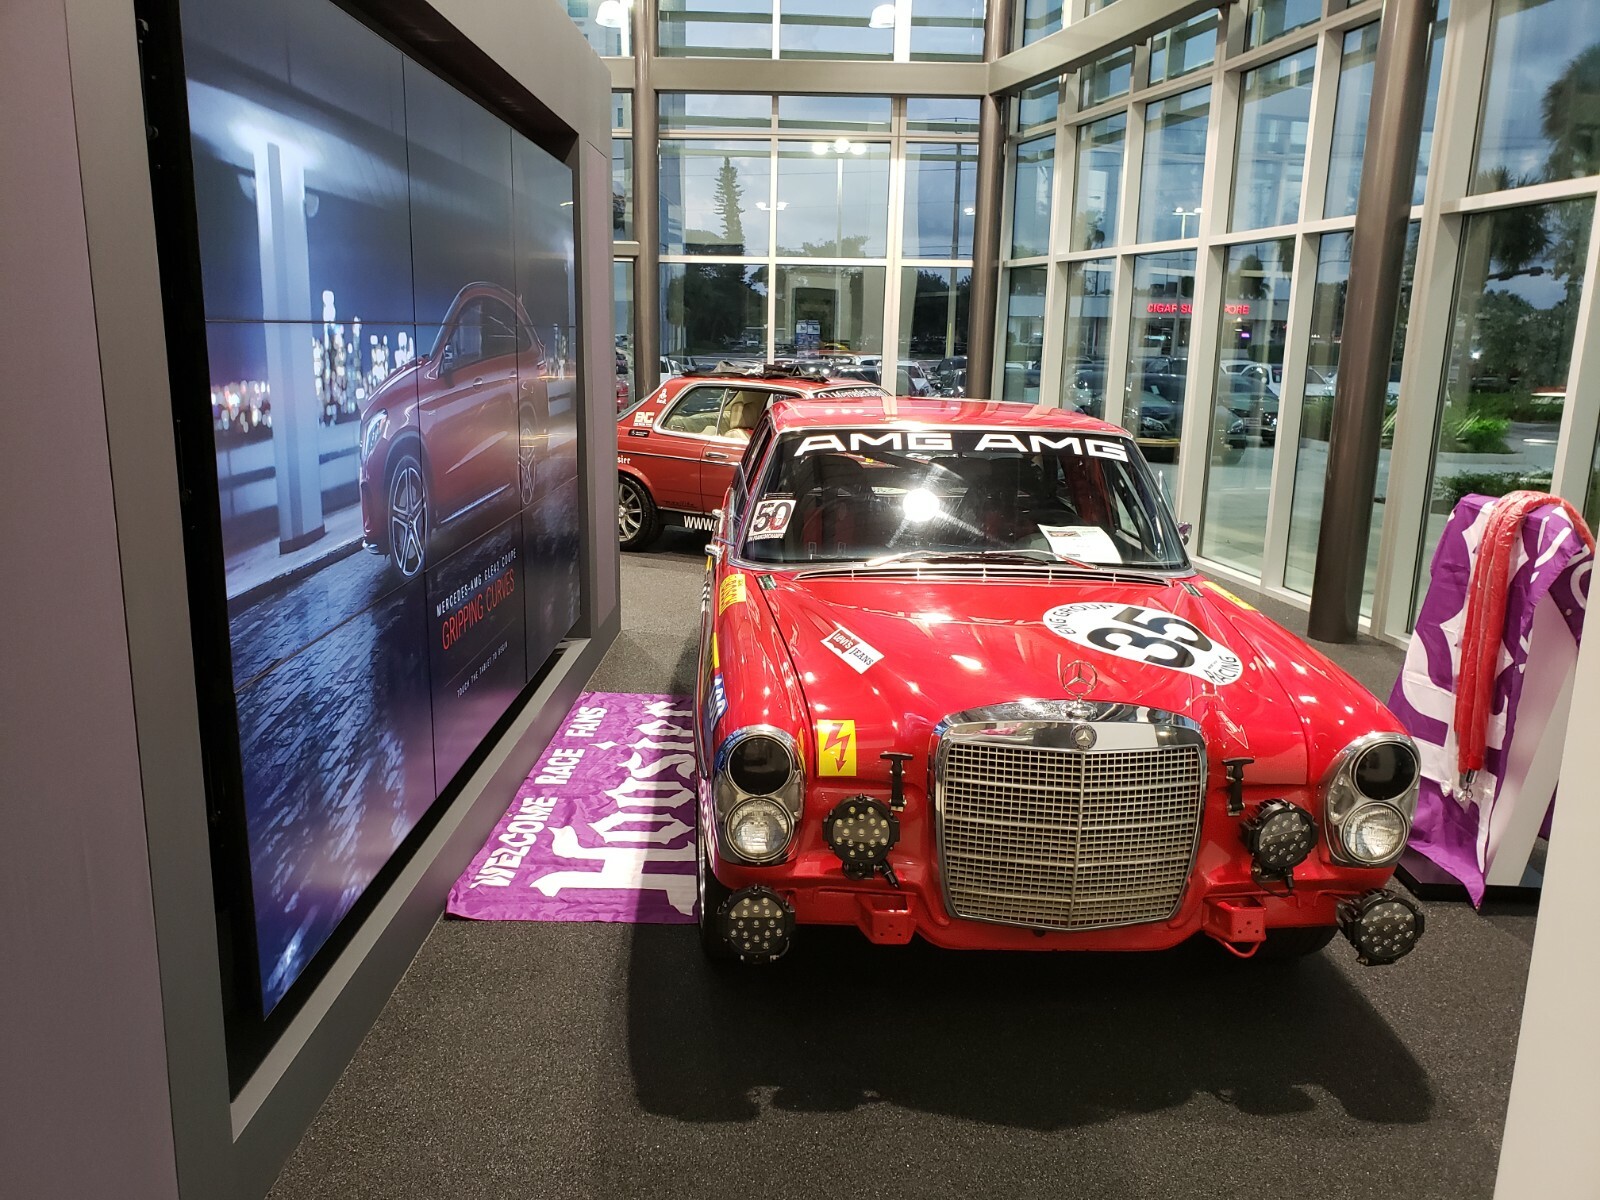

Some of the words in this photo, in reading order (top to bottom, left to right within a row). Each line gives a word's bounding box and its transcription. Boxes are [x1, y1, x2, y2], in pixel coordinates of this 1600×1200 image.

[793, 432, 953, 457] AMG
[974, 433, 1129, 463] AMG
[753, 501, 792, 532] 50
[436, 573, 482, 617] MERCEDES-AMG
[442, 593, 484, 650] GRIPPING
[485, 568, 515, 613] CURVES
[1087, 606, 1213, 668] 35
[848, 647, 874, 666] JEANS
[1204, 656, 1240, 684] RACING
[469, 796, 559, 889] WELCOME
[534, 748, 586, 785] RACE
[565, 706, 608, 738] FANS
